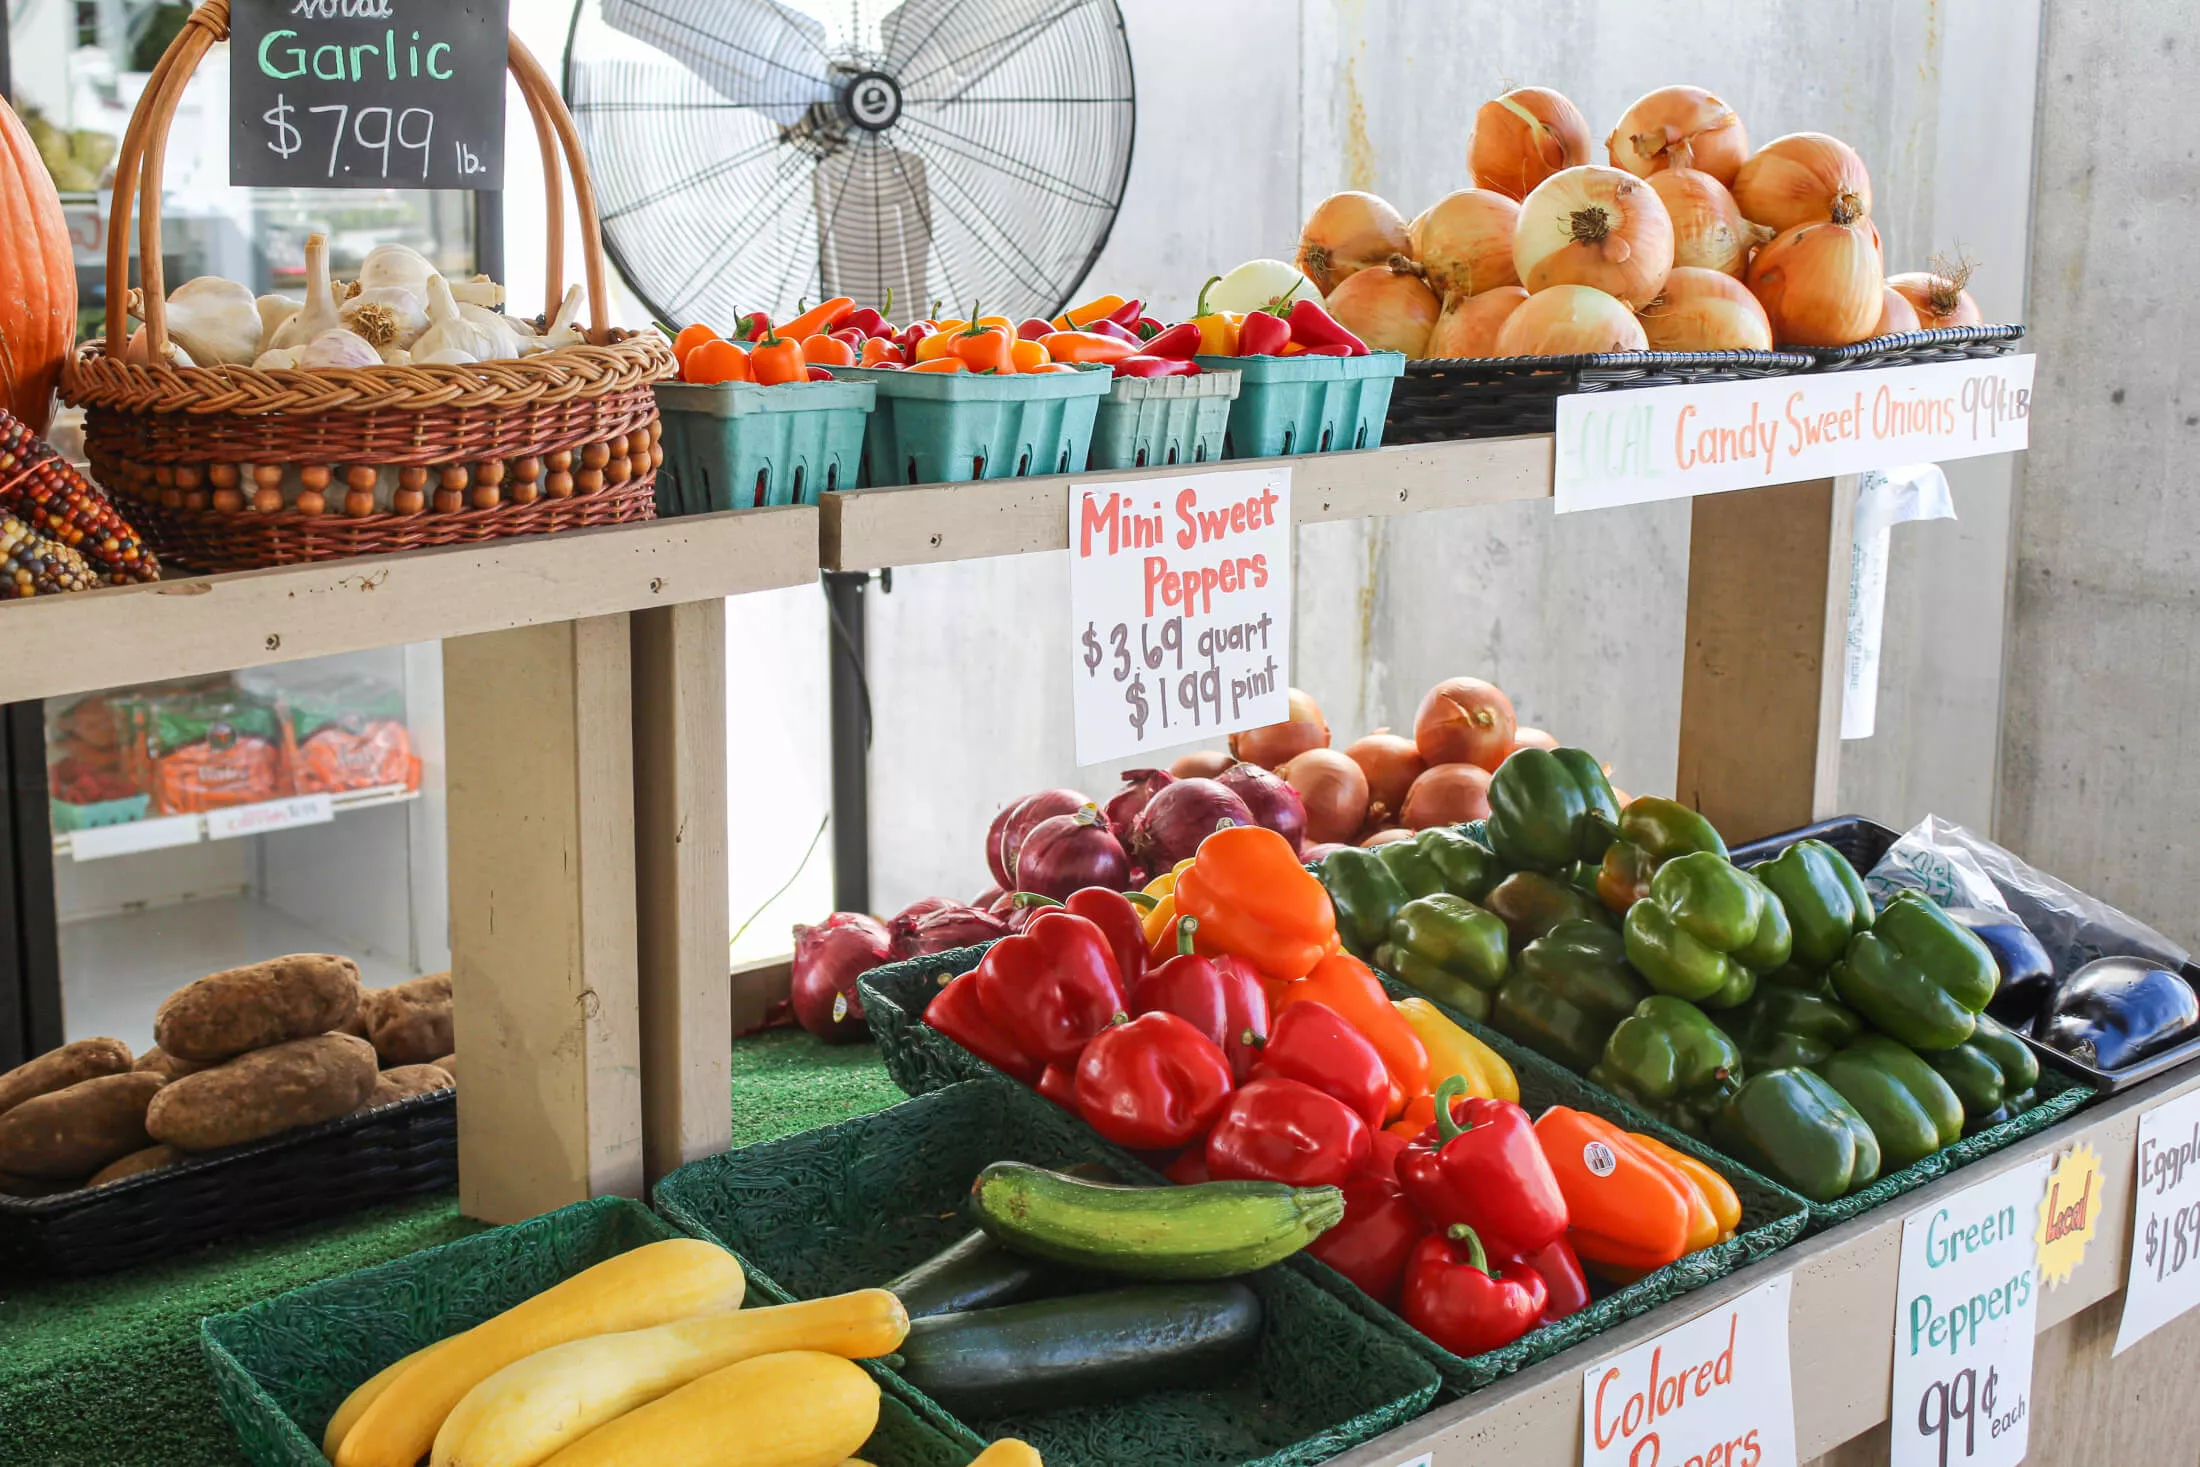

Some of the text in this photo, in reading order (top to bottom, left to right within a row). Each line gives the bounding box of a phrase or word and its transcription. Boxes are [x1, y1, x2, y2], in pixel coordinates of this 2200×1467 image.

[257, 28, 453, 82] Garlic
[262, 93, 486, 181] $7.99 lb.
[1675, 404, 1779, 475] Candy
[1785, 391, 1864, 457] Sweet
[1872, 384, 1955, 440] Onions
[1080, 488, 1279, 558] Mini Sweet
[1143, 553, 1269, 618] Peppers
[1197, 612, 1272, 669] quart
[1125, 655, 1279, 742] $1.99 pint
[2141, 1121, 2200, 1196] Eggpl
[1925, 1204, 2015, 1270] Green
[2145, 1201, 2200, 1283] $1.89
[1909, 1270, 2032, 1357] Peppers
[1594, 1311, 1738, 1450] Colored
[1918, 1364, 2025, 1467] 99¢ each
